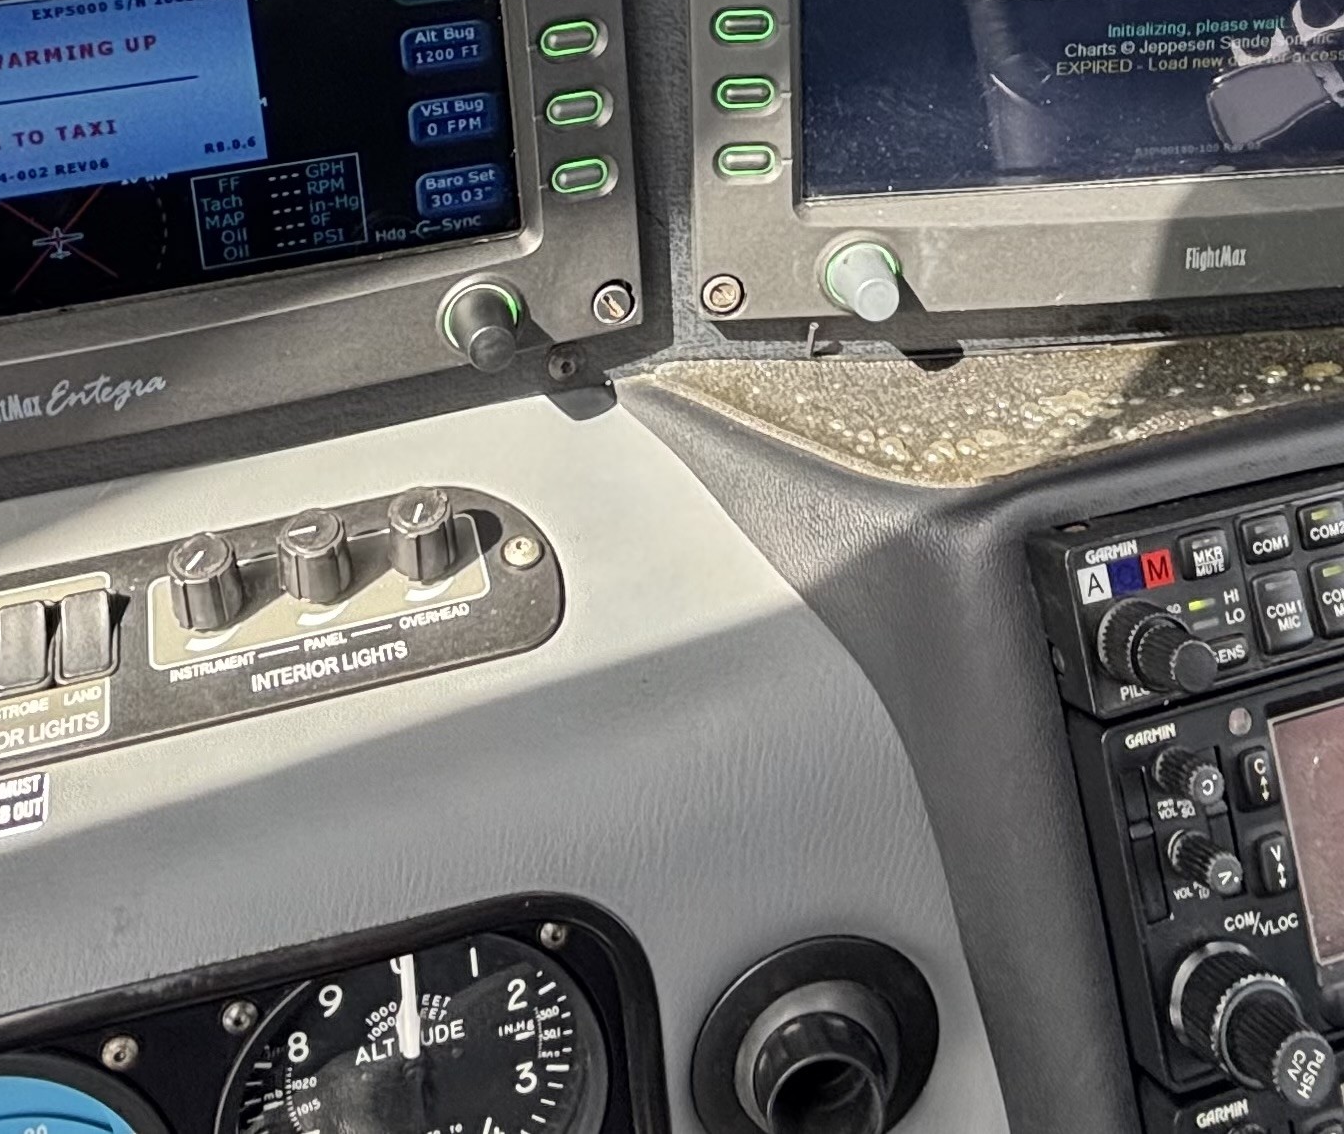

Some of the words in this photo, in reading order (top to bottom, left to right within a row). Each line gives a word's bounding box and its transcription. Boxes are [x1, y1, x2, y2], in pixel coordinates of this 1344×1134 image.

[1196, 18, 1248, 35] please
[125, 34, 158, 53] UP
[1056, 60, 1132, 76] EXPIRED
[12, 129, 44, 148] TO
[55, 120, 117, 143] TAXI
[1186, 242, 1246, 270] FlightMax
[46, 374, 167, 417] Entegra
[1085, 540, 1138, 565] GARMIN
[1253, 536, 1289, 555] COM1
[400, 603, 469, 630] OVERHEAD
[304, 632, 346, 651] PANEL
[169, 652, 255, 683] INSTRUMENT
[252, 657, 339, 692] INTERIOR
[342, 641, 408, 674] LIGHTS
[64, 686, 101, 706] LAND
[29, 711, 99, 744] LIGHTS
[1, 774, 42, 798] MUST
[14, 799, 43, 821] OUT
[1224, 912, 1299, 937] COM/VLOC
[318, 984, 343, 1017] 9
[507, 978, 528, 1011] 2
[288, 1032, 310, 1063] 8
[515, 1061, 537, 1094] 3
